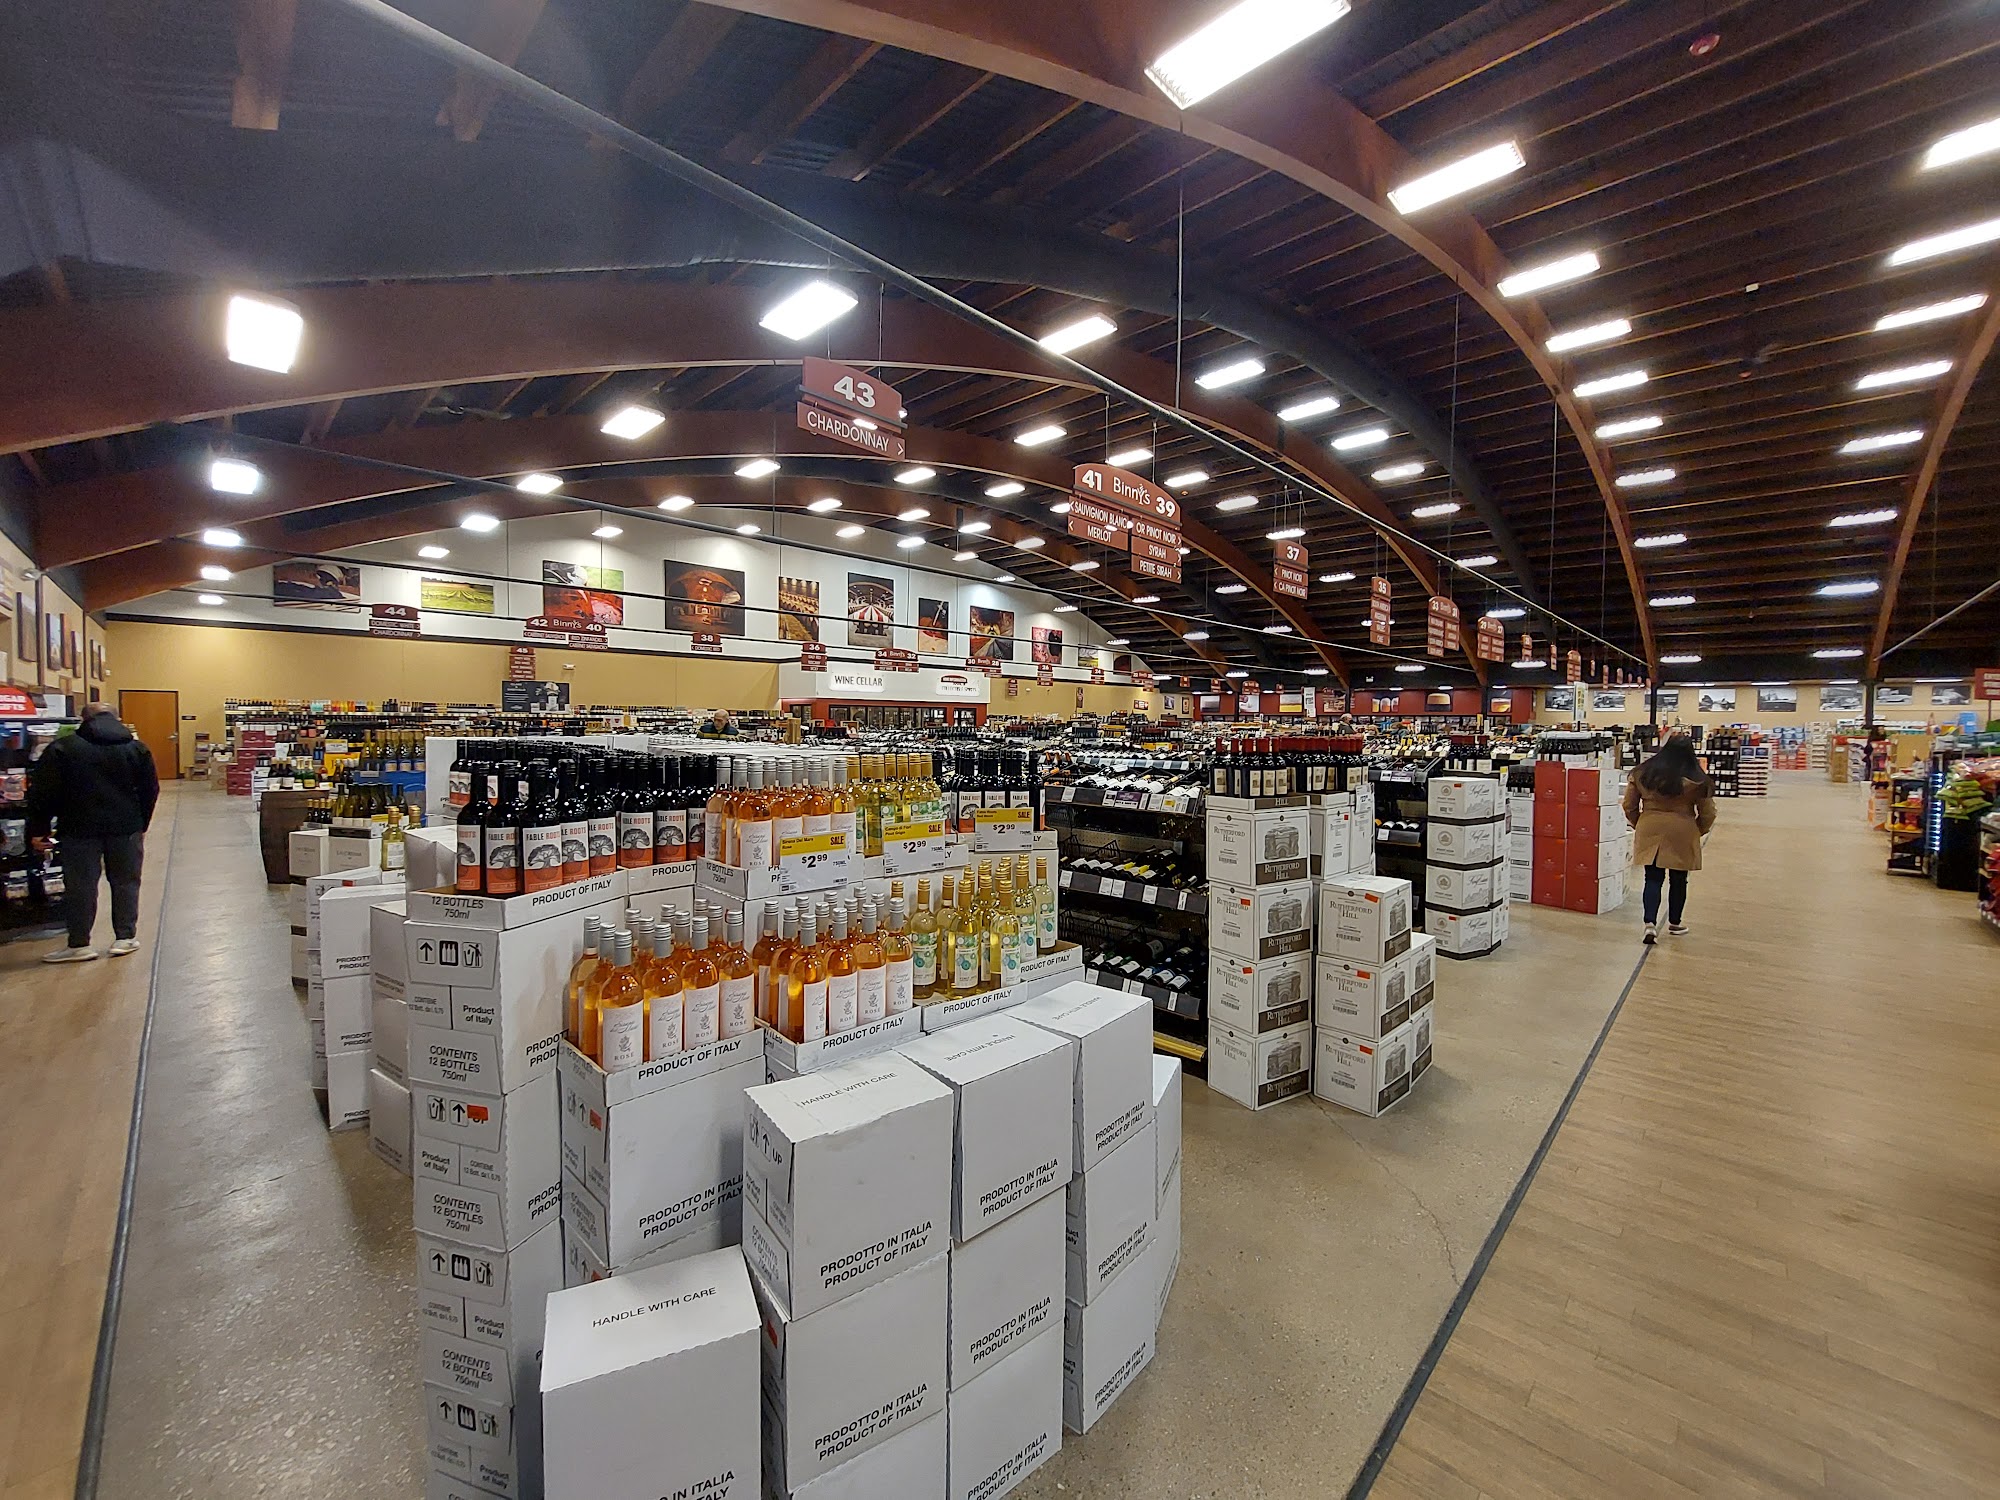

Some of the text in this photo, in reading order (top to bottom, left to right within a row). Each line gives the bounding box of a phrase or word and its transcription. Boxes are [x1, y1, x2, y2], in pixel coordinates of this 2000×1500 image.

[834, 376, 876, 408] 43
[807, 411, 889, 451] CHARDONNAY
[1082, 469, 1176, 517] 41 Binny's 39
[1074, 502, 1127, 530] SAUVIGNON BLANC
[1087, 525, 1112, 543] MERLOT
[1136, 522, 1177, 545] OR PINOT NOIR
[1148, 545, 1167, 559] SYRAH
[1286, 545, 1300, 561] 37
[1139, 560, 1172, 578] PETITE SIRAH
[1378, 581, 1387, 594] 35
[384, 607, 407, 616] 44
[530, 619, 603, 632] 42 Binny's 40
[373, 629, 413, 637] CHARDONNAY
[700, 634, 714, 642] 38
[834, 676, 883, 687] WINE CELLAR
[634, 817, 651, 825] ROOTS
[669, 814, 684, 822] ROOTS
[569, 827, 587, 836] ROOTS
[597, 822, 614, 831] ROOTS
[928, 824, 942, 833] SALE
[1213, 826, 1246, 838] RUTHERFORD
[488, 832, 505, 840] FABLE
[526, 832, 544, 840] FABLE
[830, 836, 844, 845] SALE
[1222, 834, 1236, 843] HILL
[652, 863, 696, 876] PRODUCT
[706, 862, 734, 877] 12 BOTTLES
[1264, 861, 1300, 874] RUTHERFORD
[713, 873, 727, 884] 750ml
[1275, 869, 1290, 880] HILL
[532, 880, 612, 906] PRODUCT OF ITALY
[432, 895, 484, 909] 12 BOTTLES
[1329, 900, 1373, 915] RUTHERFORD
[444, 908, 470, 919] 750ml
[1342, 909, 1359, 920] HILL
[1267, 933, 1303, 948] RUTHERFORD
[1278, 942, 1293, 952] HILL
[1020, 961, 1045, 974] RODUCT
[1055, 953, 1071, 964] ITALY
[1216, 966, 1249, 985] RUTHERFORD
[1326, 973, 1368, 990] RUTHERFORD
[1225, 978, 1239, 989] HILL
[1338, 982, 1355, 994] HILL
[943, 997, 980, 1014] PRODUCT
[981, 994, 993, 1005] OF
[993, 989, 1012, 1002] ITALY
[463, 1005, 495, 1015] Product
[465, 1014, 493, 1025] of Italy
[430, 1045, 478, 1062] CONTENTS
[428, 1056, 480, 1073] 12 BOTTLES
[442, 1069, 467, 1082] 750ml
[800, 1071, 898, 1108] HANDLE WITH CARE
[422, 1151, 451, 1165] Product
[773, 1148, 783, 1165] UP
[432, 1162, 448, 1175] Italy
[470, 1160, 494, 1171] CONTIENE
[979, 1158, 1058, 1207] PRODOTTO IN ITALIA
[820, 1220, 933, 1277] PRODOTTO IN ITALIA
[824, 1235, 929, 1289] PRODUCT OF ITALY
[592, 1287, 718, 1328] HANDLE WITH CARE
[672, 1470, 735, 1500] IN ITALIA
